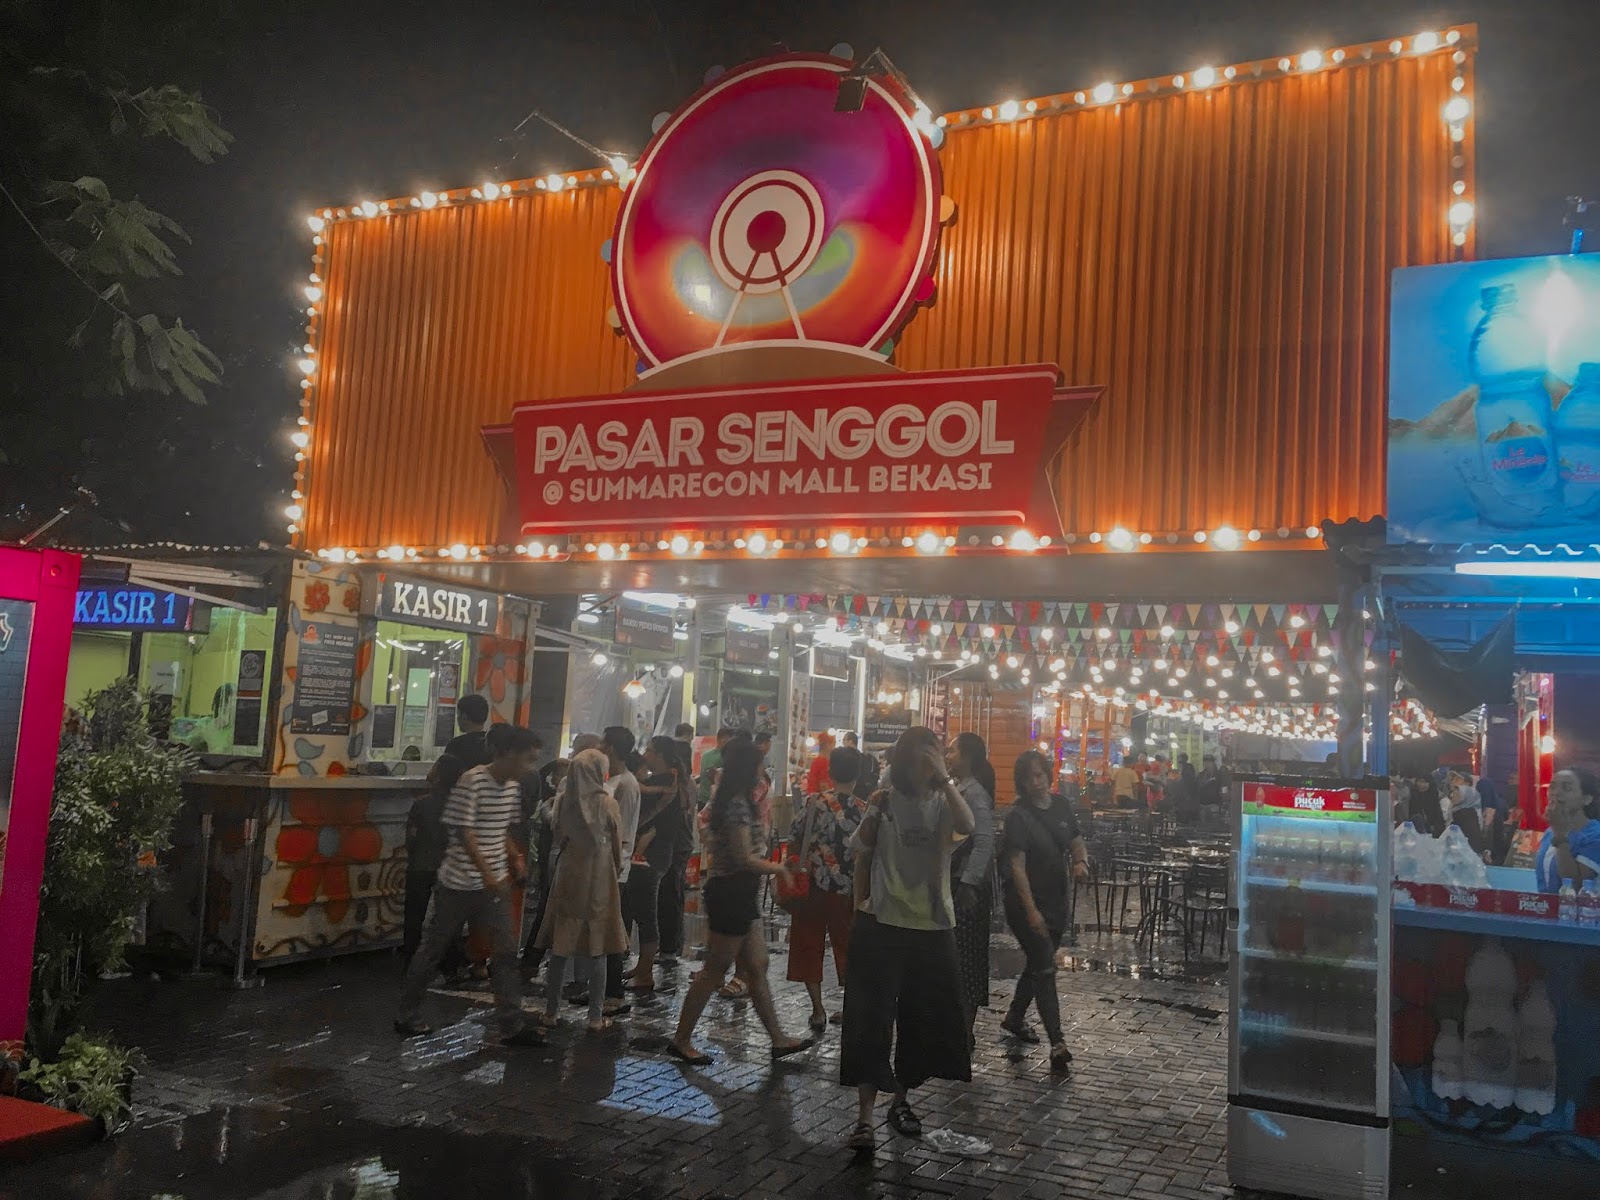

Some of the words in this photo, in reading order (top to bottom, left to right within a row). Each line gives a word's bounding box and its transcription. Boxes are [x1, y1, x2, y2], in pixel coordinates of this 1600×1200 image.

[534, 416, 705, 474] PASAR
[716, 400, 1015, 465] SENGGOL
[542, 480, 564, 505] @
[569, 469, 770, 503] SUMMARECON
[779, 467, 860, 495] MALL
[868, 462, 993, 492] BEKASI
[73, 590, 156, 623] KASIR
[162, 592, 176, 624] 1
[392, 581, 472, 624] KASIR
[477, 598, 489, 627] 1
